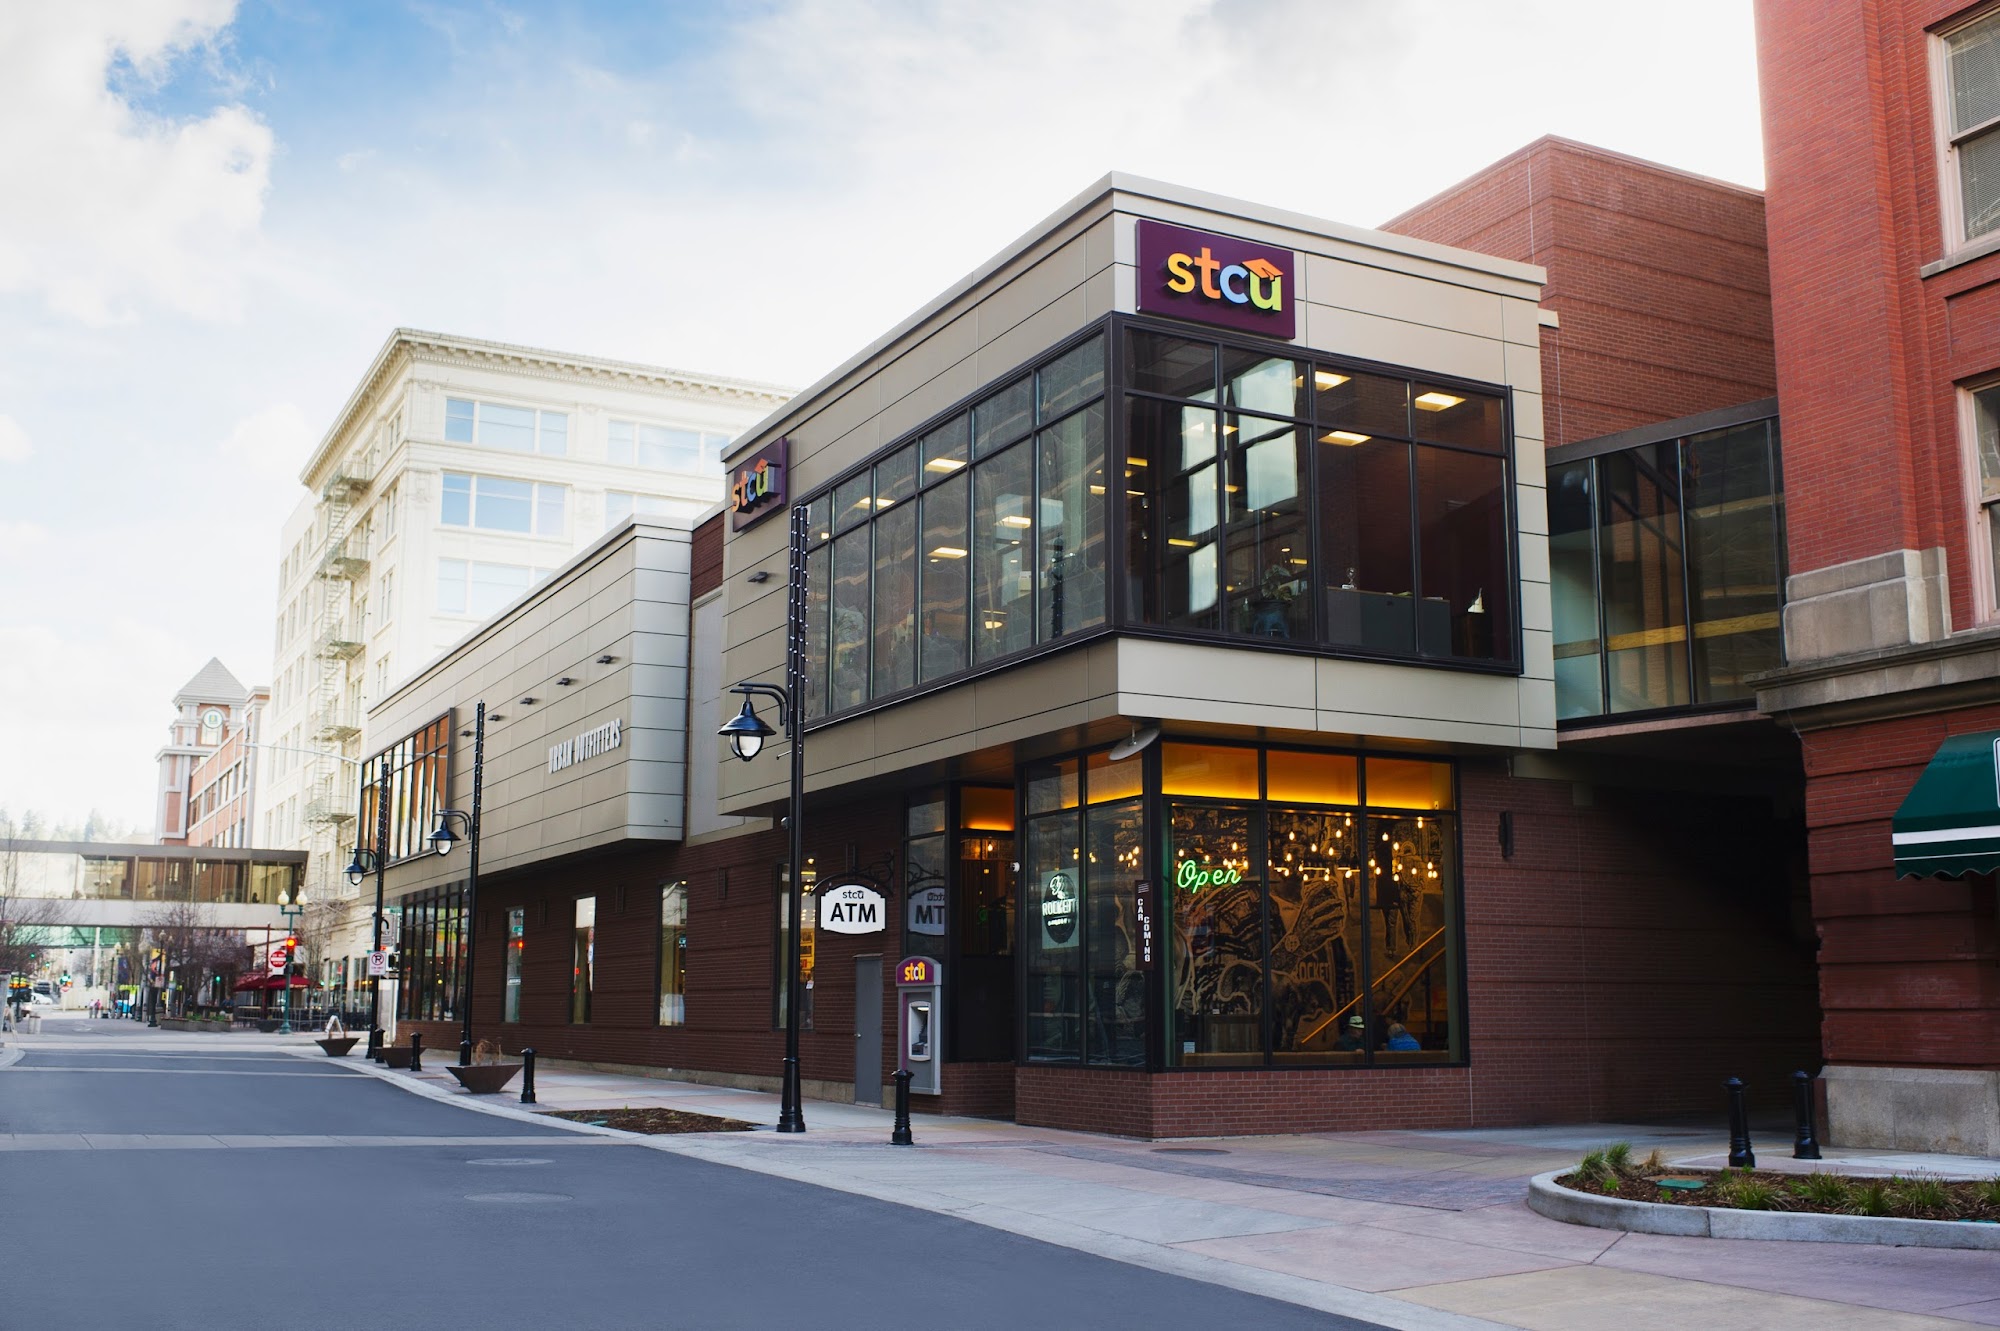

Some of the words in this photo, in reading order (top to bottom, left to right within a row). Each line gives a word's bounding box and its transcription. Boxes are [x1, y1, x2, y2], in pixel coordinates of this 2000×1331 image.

[1167, 247, 1284, 312] stcu
[731, 458, 769, 513] stcu
[548, 738, 573, 774] URBAN
[574, 717, 622, 764] OUTFITTERS
[1177, 860, 1241, 894] Open
[842, 890, 864, 899] stcu
[830, 902, 877, 923] ATM
[1143, 916, 1152, 963] COMING
[904, 961, 925, 981] stcu
[1298, 961, 1330, 981] OCKET
